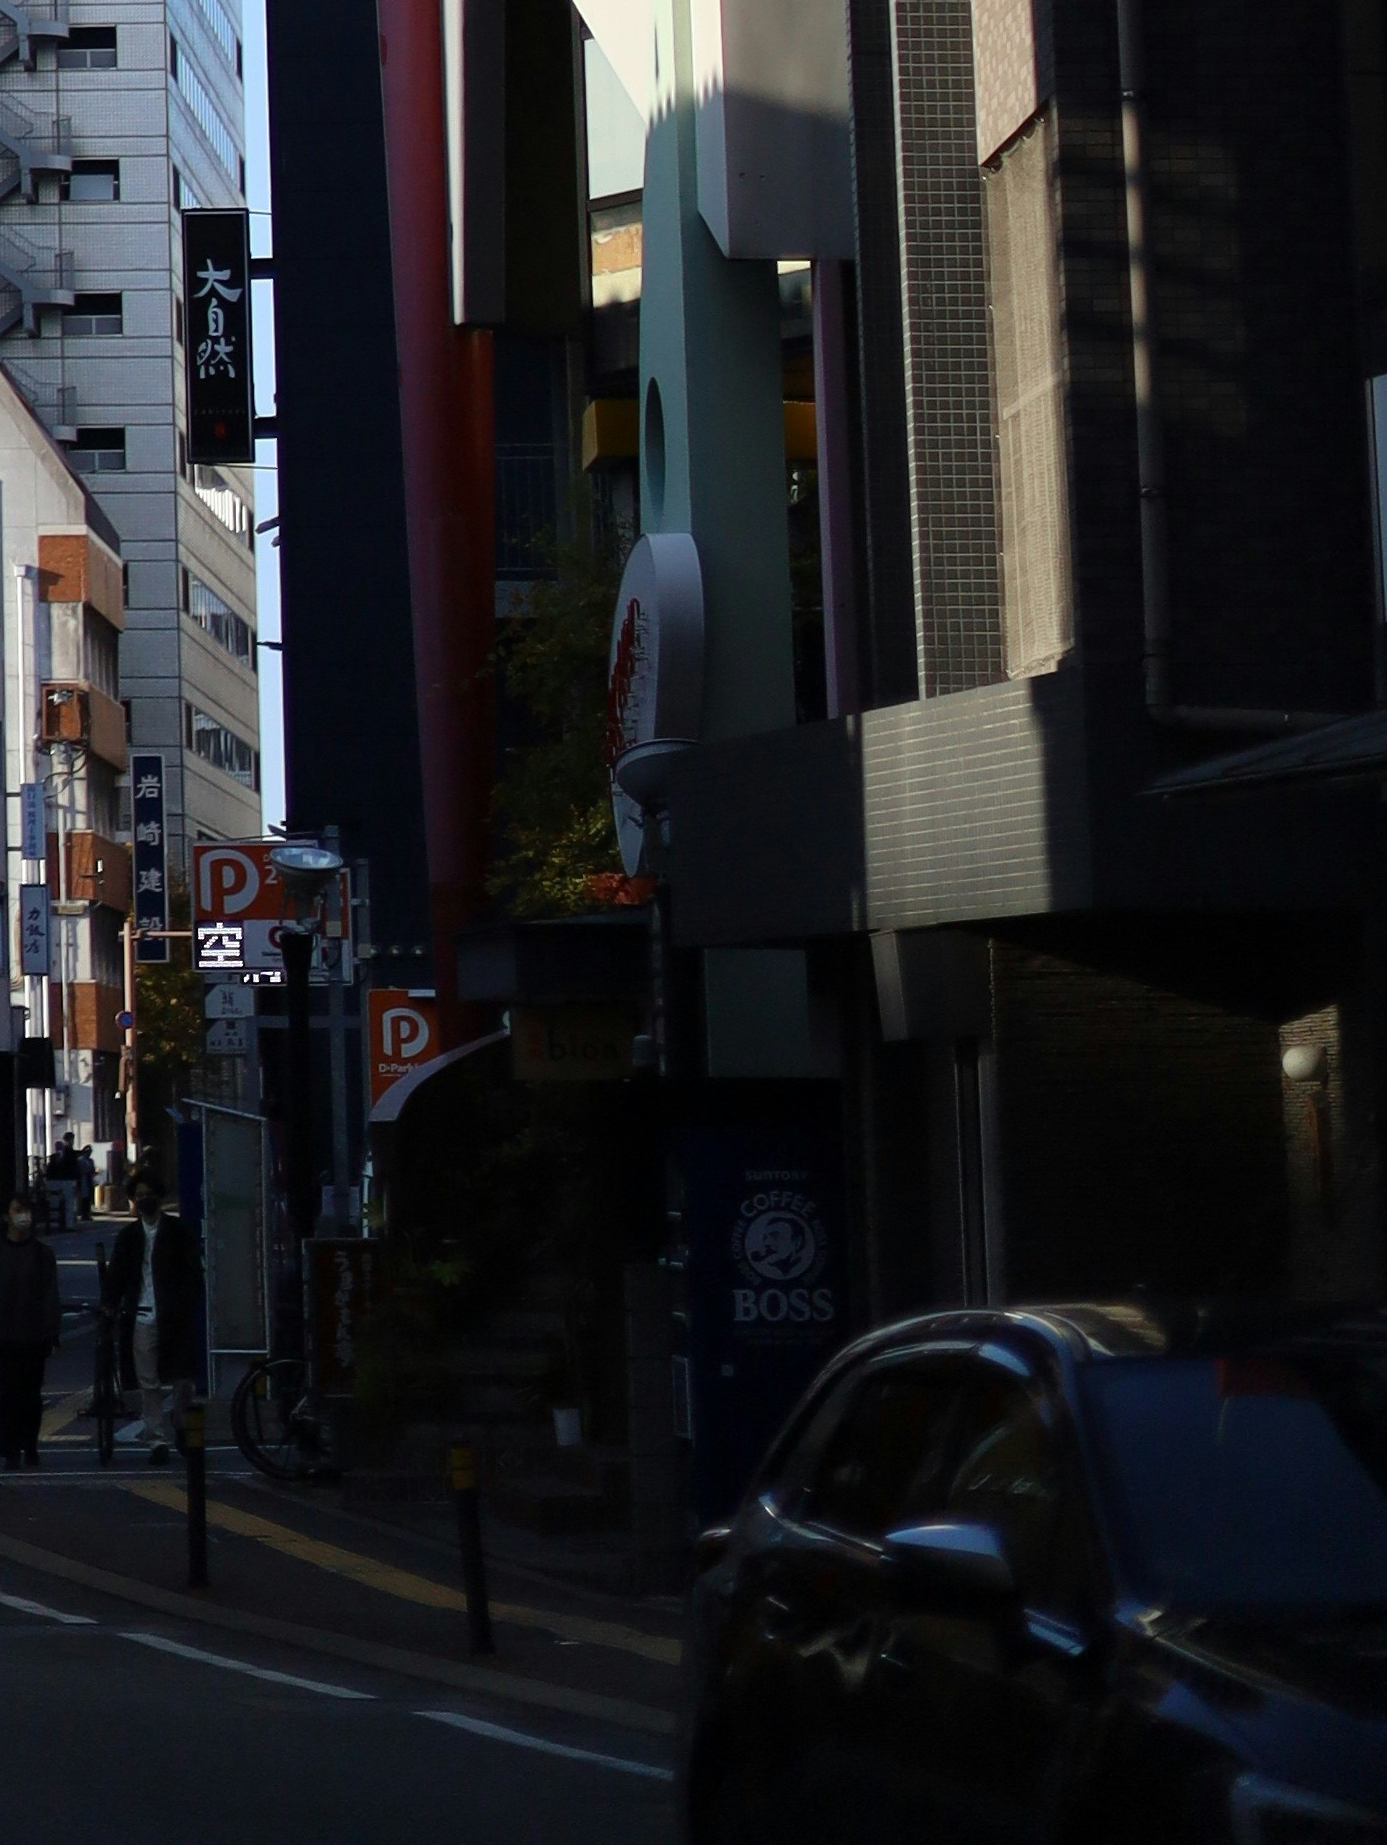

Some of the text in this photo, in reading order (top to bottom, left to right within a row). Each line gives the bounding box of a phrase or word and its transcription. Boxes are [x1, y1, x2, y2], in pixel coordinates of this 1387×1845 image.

[192, 259, 243, 380] 大自然
[135, 774, 163, 941] 岩崎建設
[197, 922, 243, 968] 空
[740, 1190, 816, 1217] COFFEE
[732, 1288, 834, 1322] BOSS
